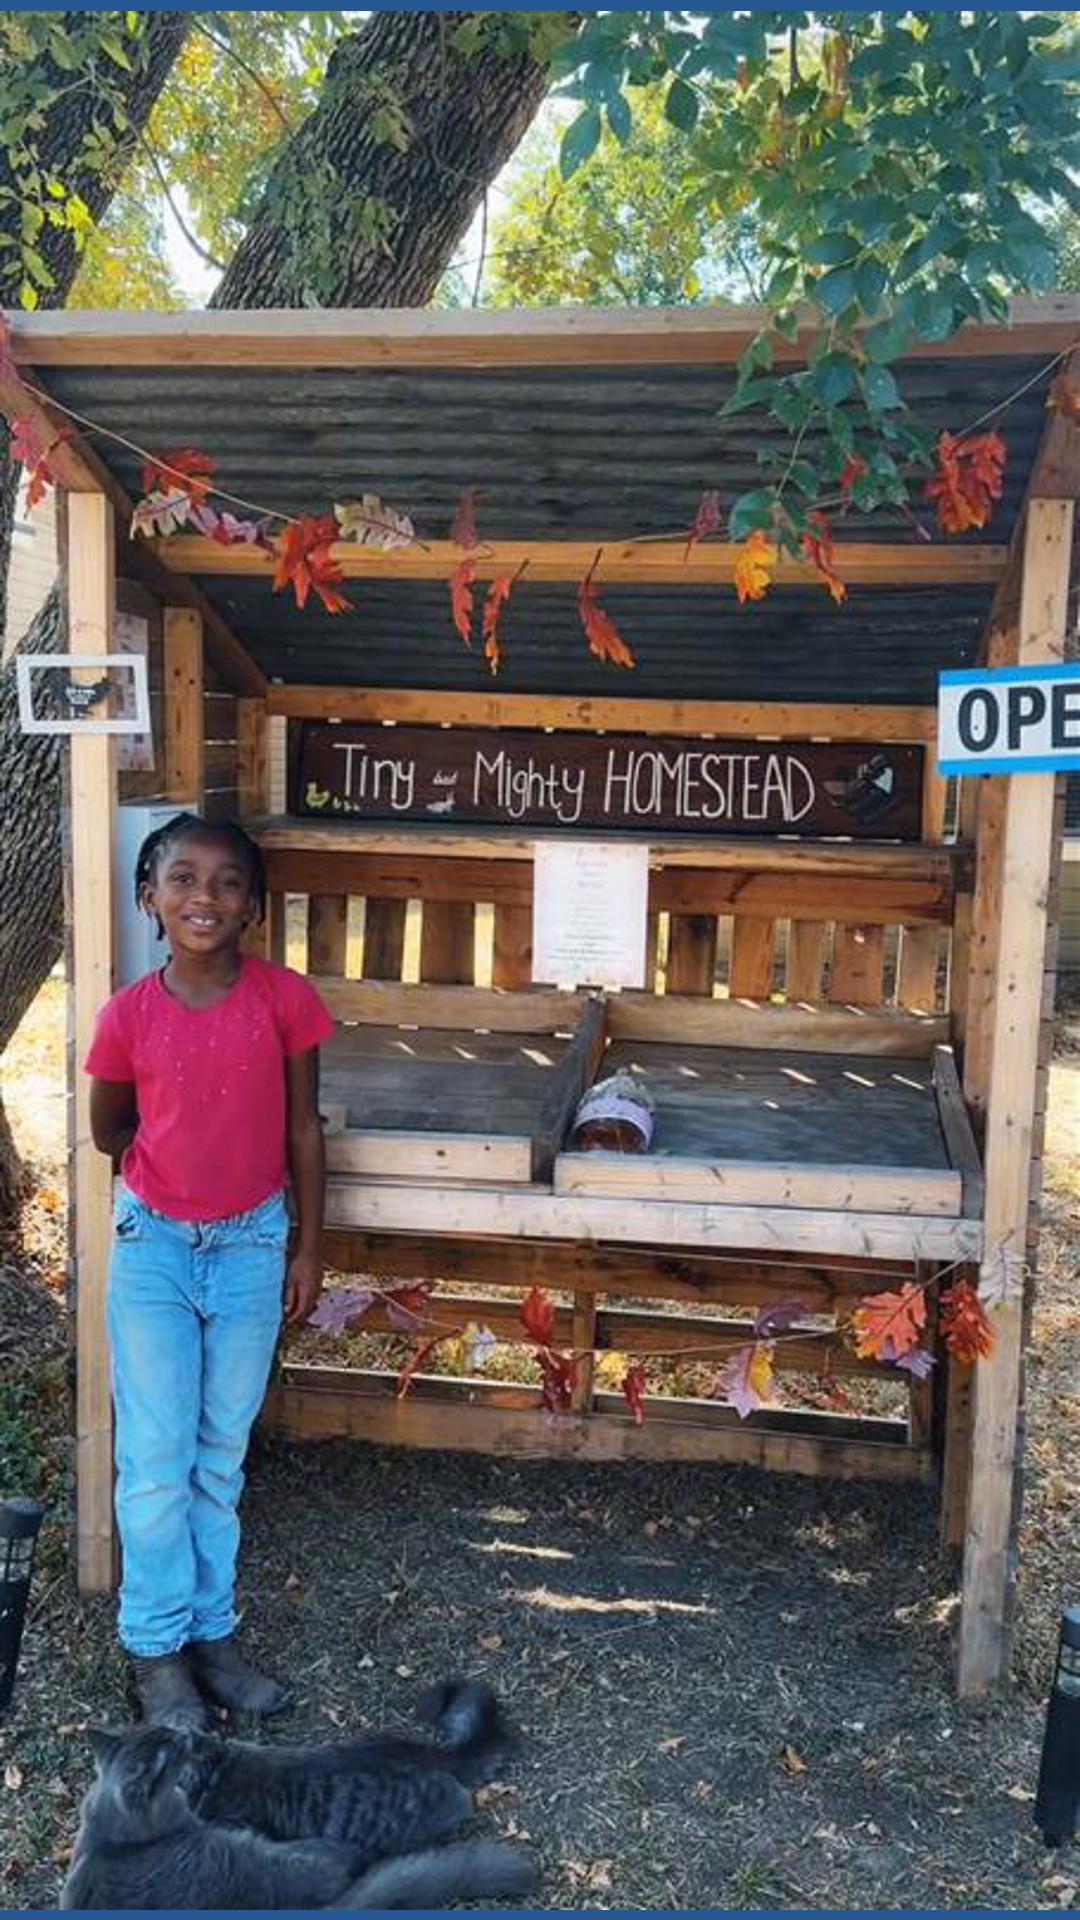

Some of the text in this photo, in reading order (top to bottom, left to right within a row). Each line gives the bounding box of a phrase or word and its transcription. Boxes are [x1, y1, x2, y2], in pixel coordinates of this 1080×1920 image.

[333, 743, 415, 809] Tiny
[473, 751, 585, 822] Mighty
[604, 750, 815, 822] HOMESTEAD
